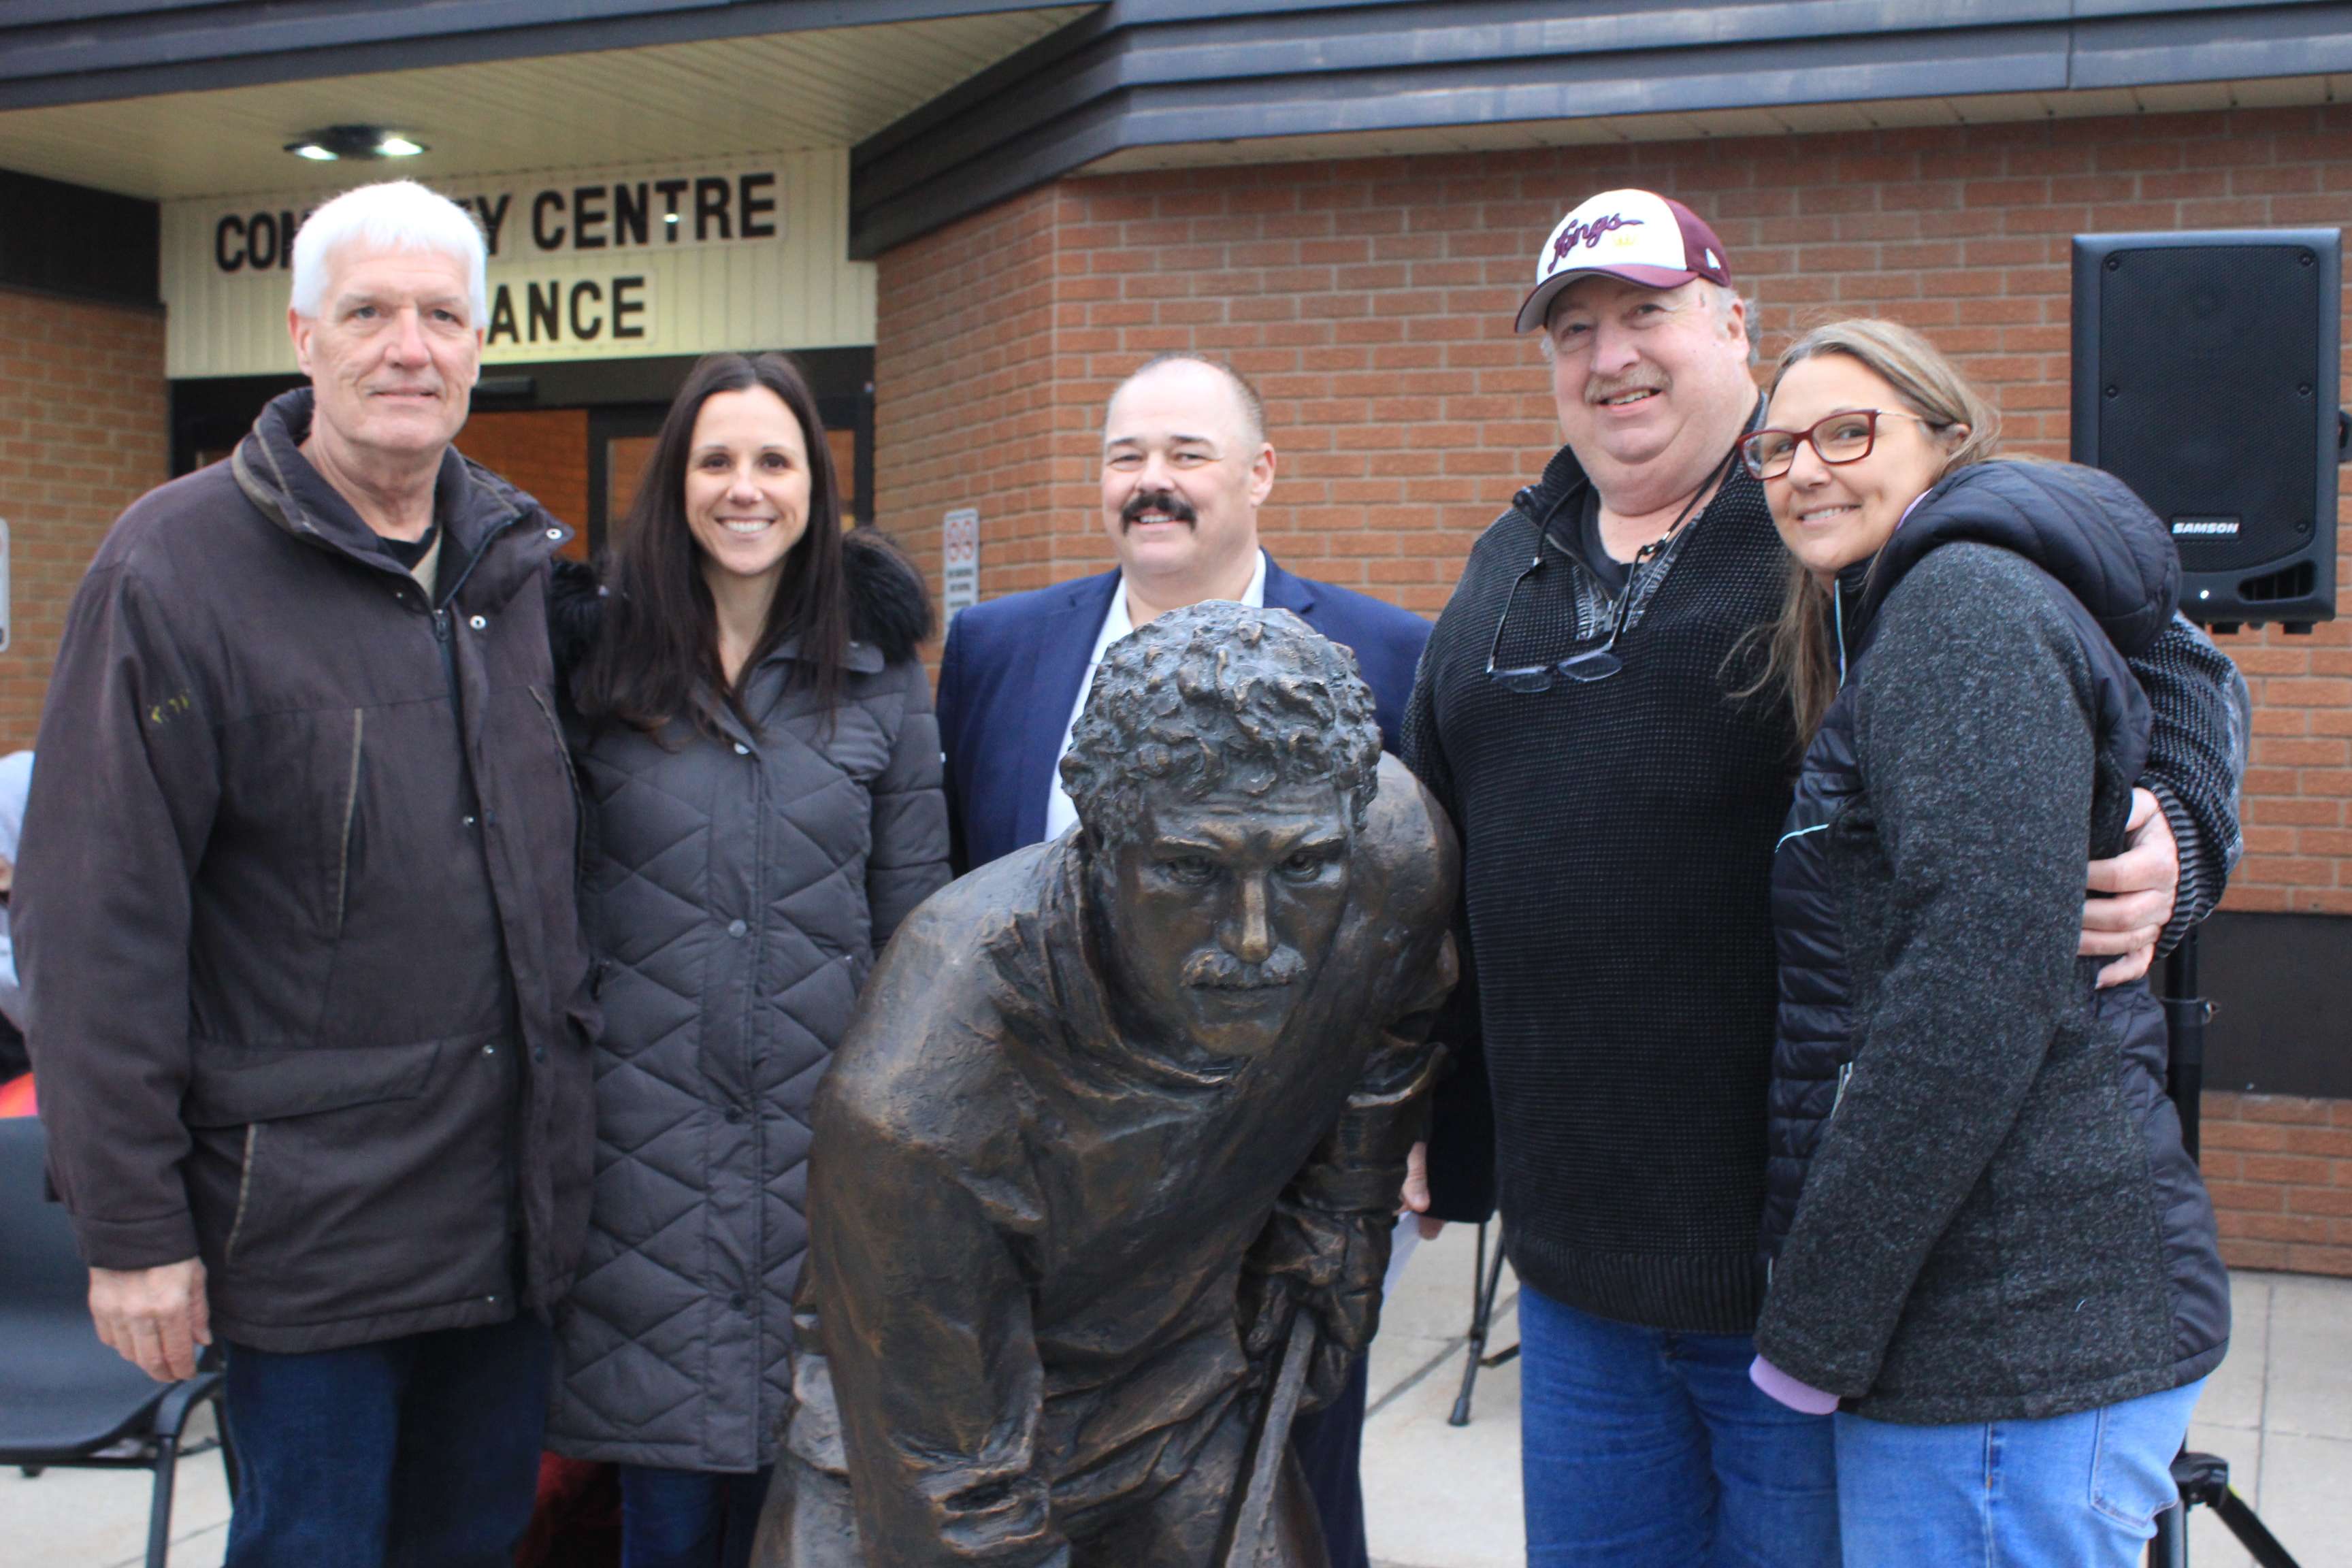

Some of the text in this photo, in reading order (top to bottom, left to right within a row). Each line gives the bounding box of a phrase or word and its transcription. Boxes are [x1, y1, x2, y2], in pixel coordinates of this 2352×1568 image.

[533, 173, 777, 252] CENTRE
[487, 276, 645, 344] ANCE
[2172, 523, 2239, 534] SAMSON
